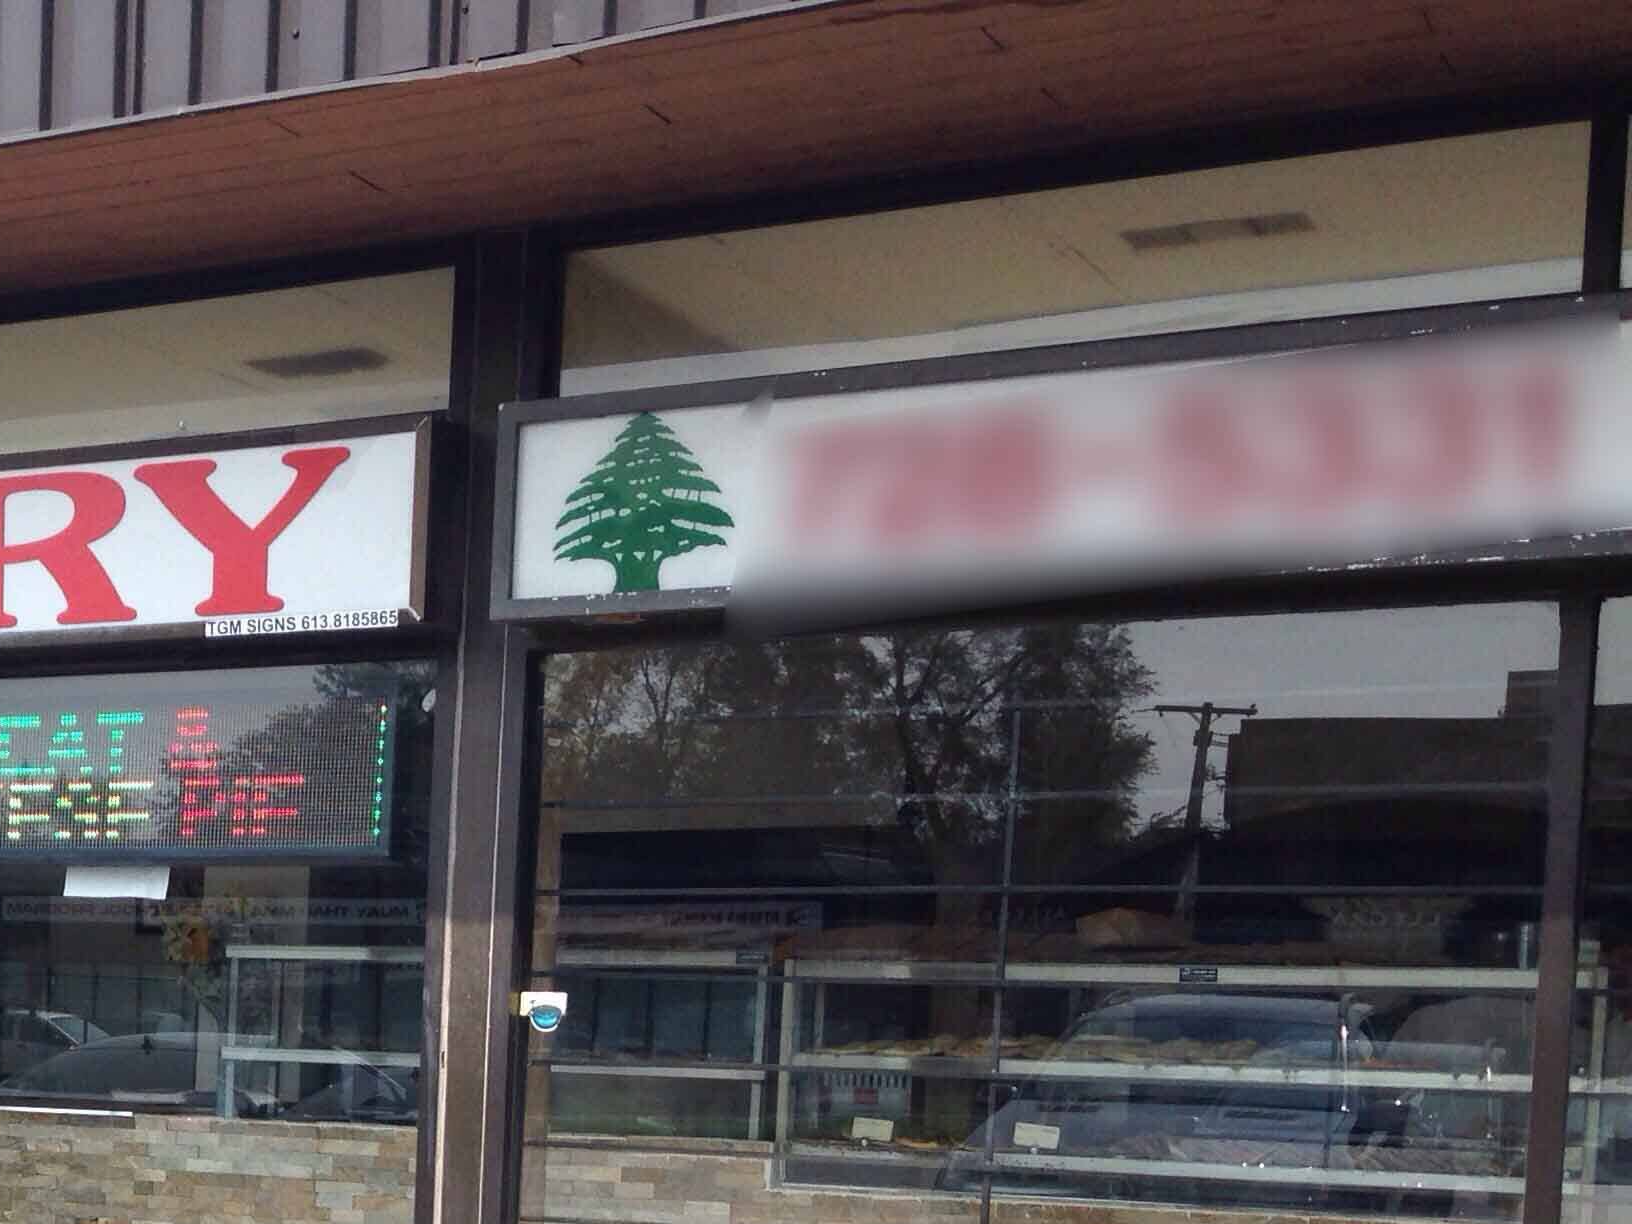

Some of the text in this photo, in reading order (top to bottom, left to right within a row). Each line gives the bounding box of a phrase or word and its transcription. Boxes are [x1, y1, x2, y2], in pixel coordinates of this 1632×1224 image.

[208, 609, 398, 636] TGM SIGNS 613.8185865
